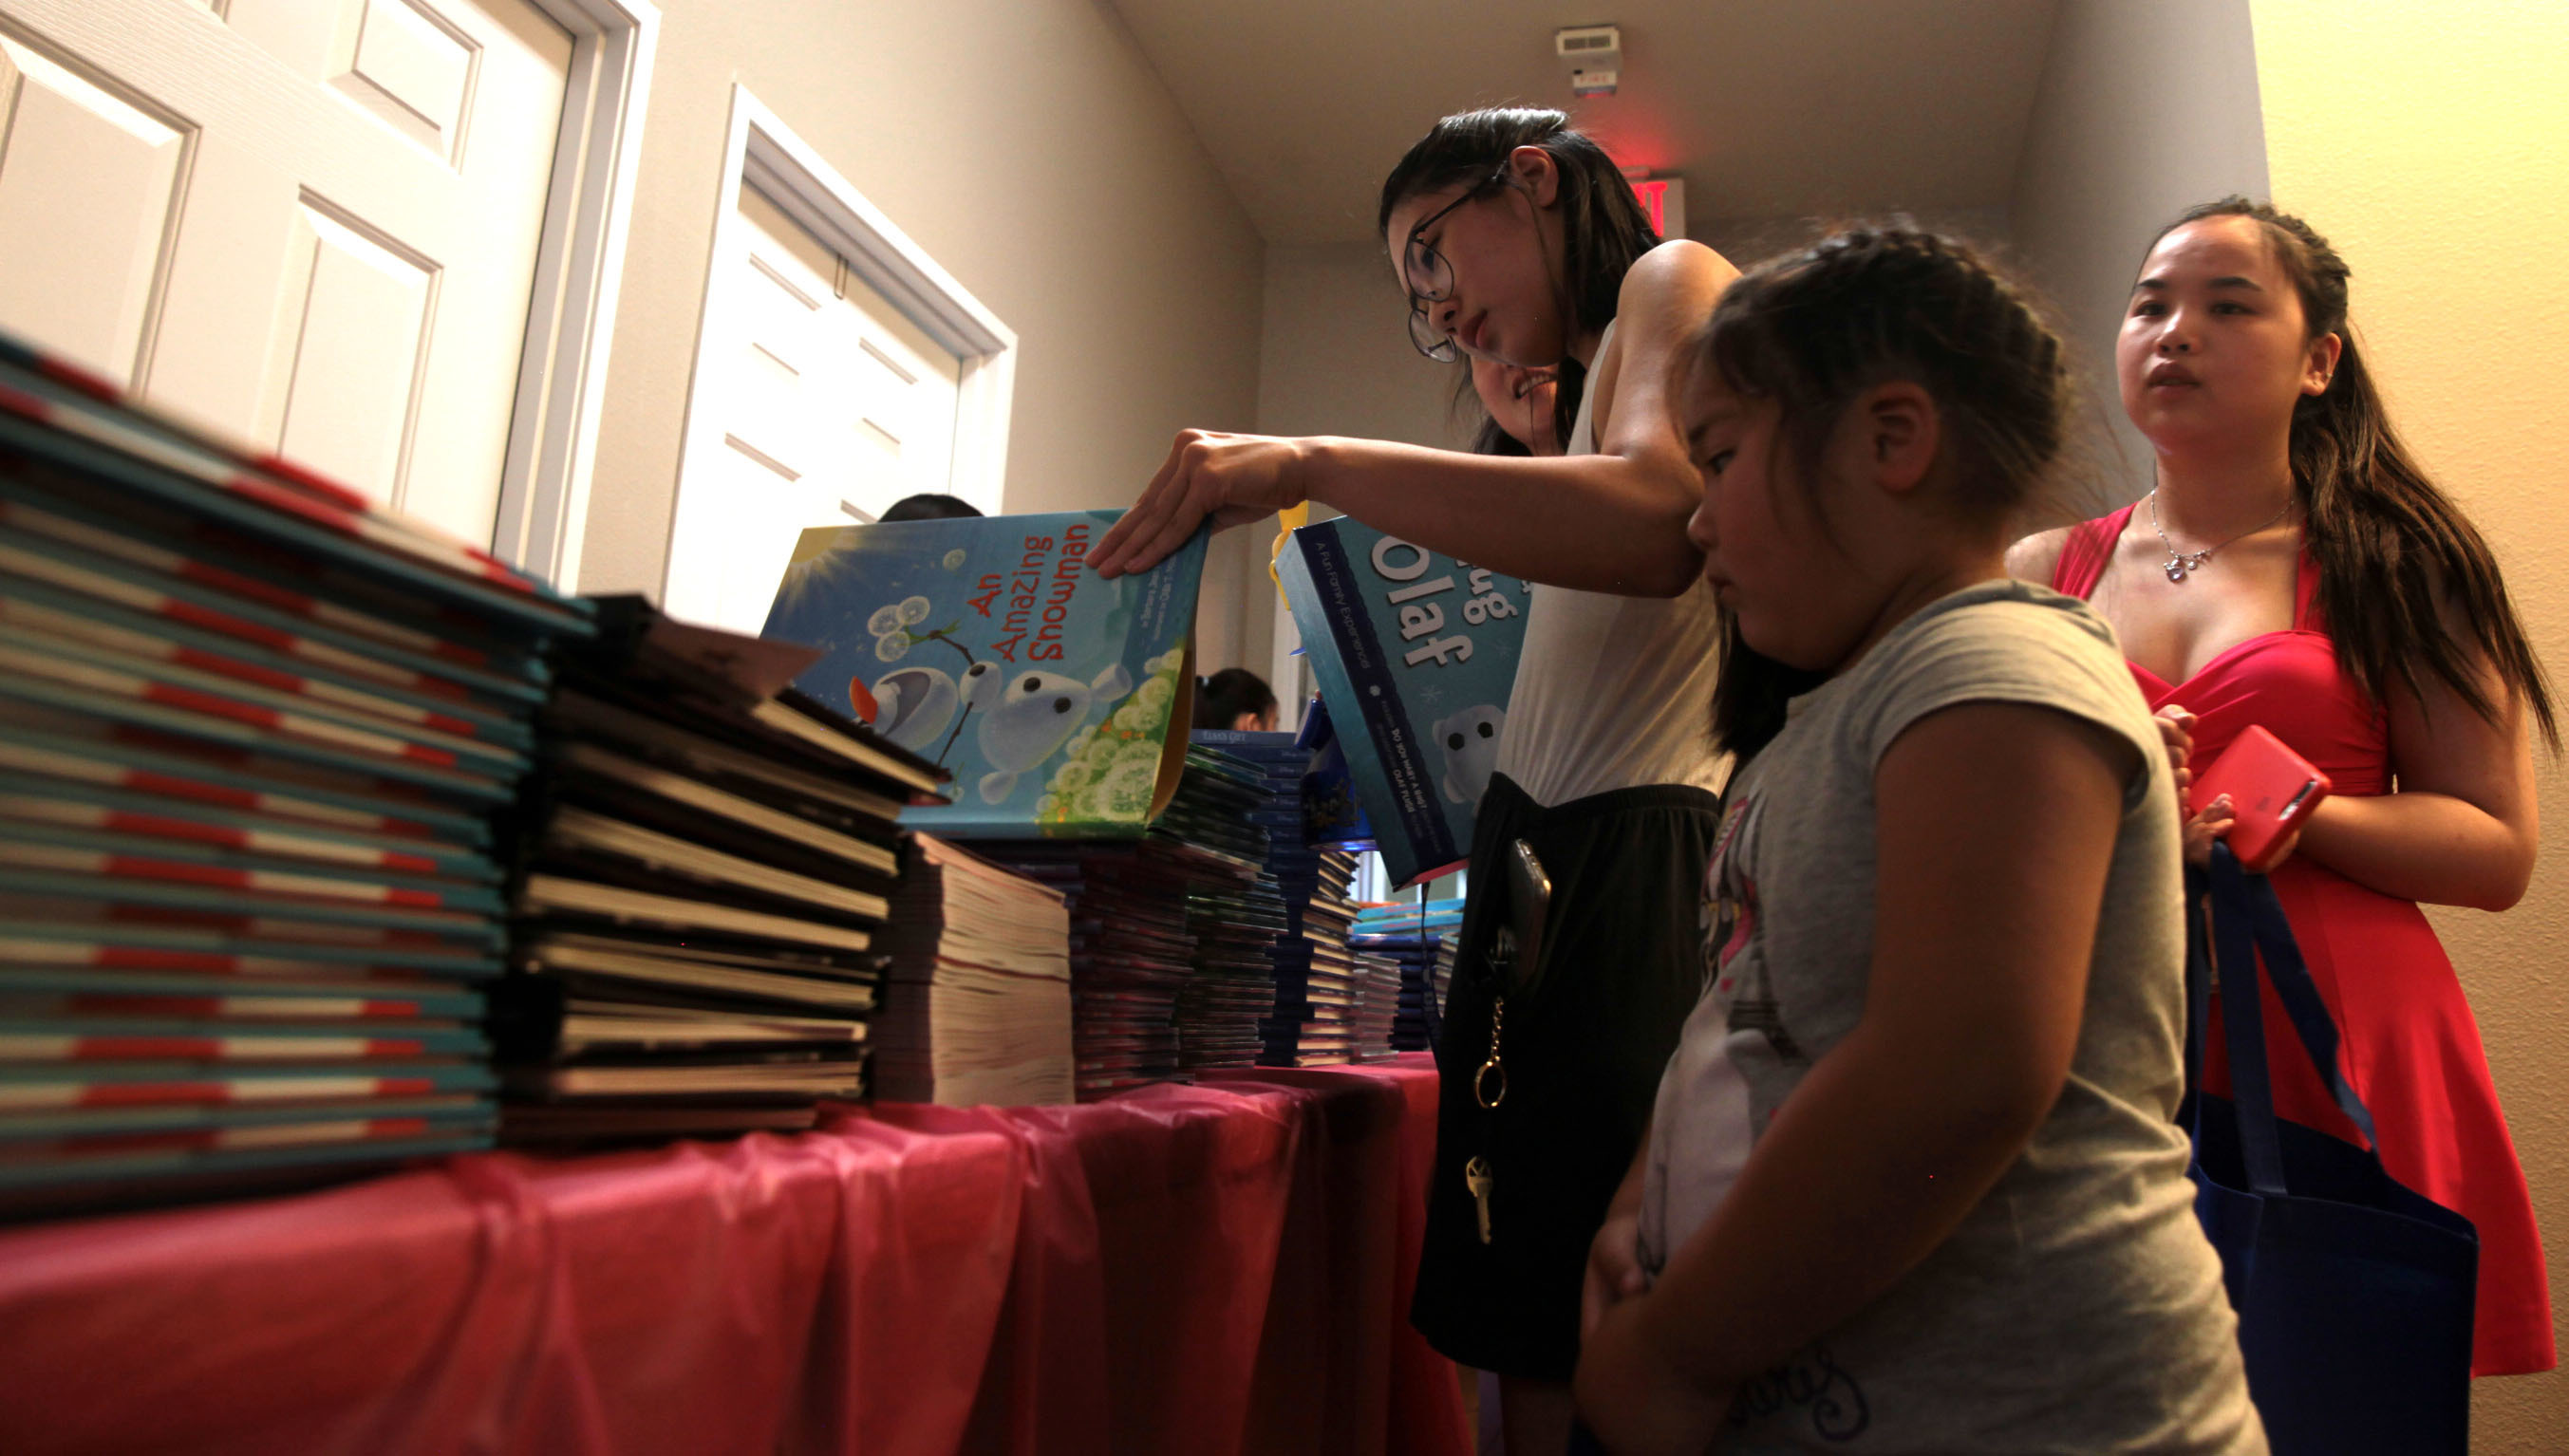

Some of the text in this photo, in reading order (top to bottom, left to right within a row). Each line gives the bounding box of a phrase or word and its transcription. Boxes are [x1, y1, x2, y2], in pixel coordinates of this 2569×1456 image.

[1315, 540, 1327, 551] A
[1318, 550, 1335, 572] Fun
[966, 572, 1003, 619] An
[991, 536, 1053, 663] Amazing
[1028, 524, 1090, 661] Snowman
[1323, 570, 1349, 607] Family
[1371, 535, 1473, 666] Olaf
